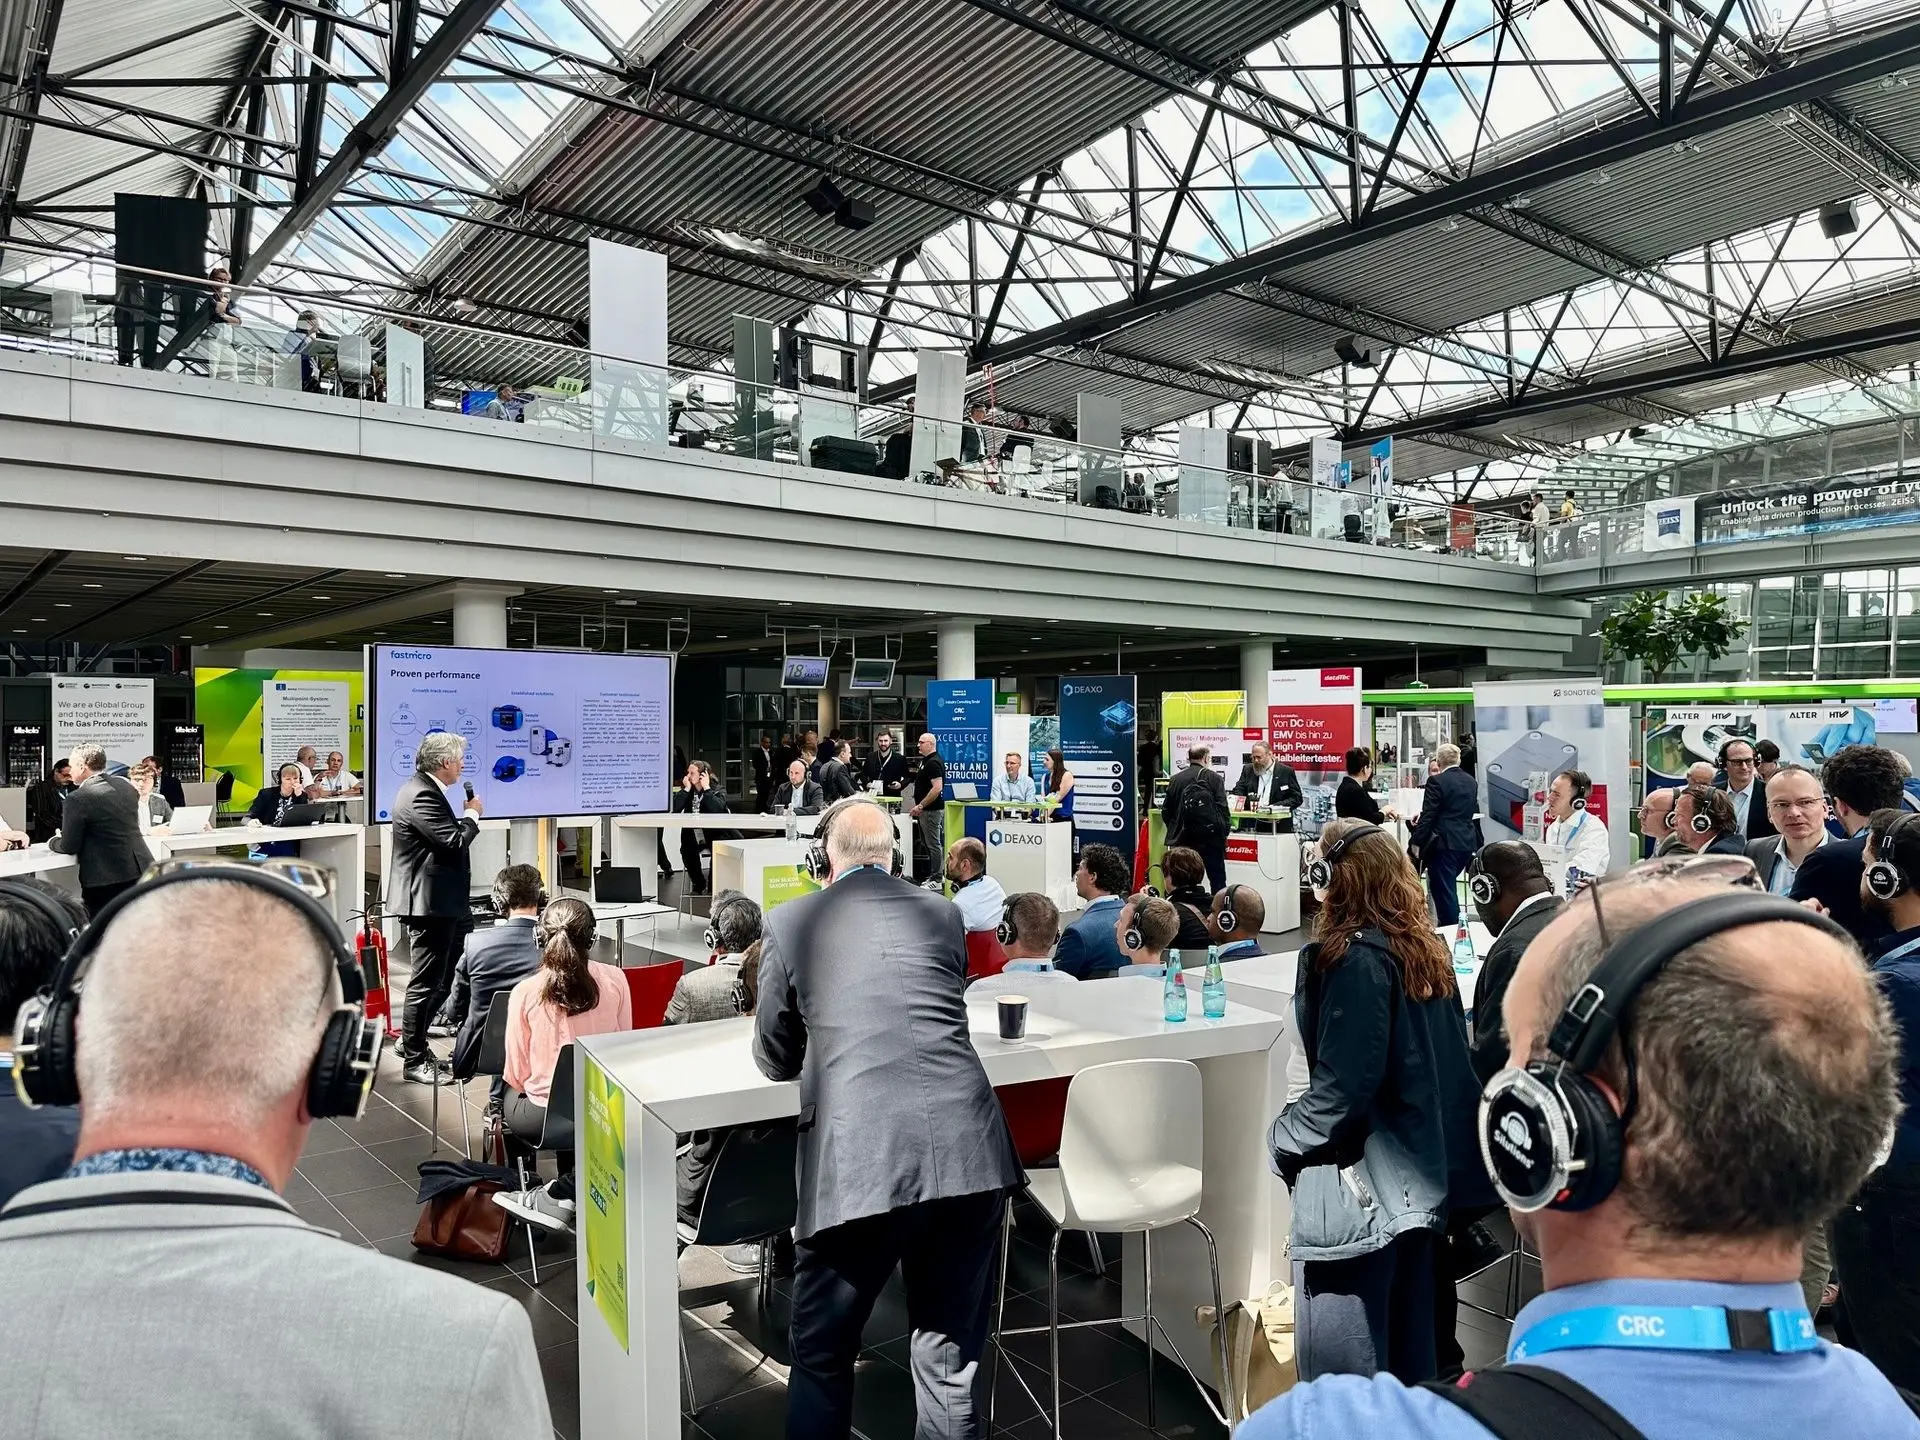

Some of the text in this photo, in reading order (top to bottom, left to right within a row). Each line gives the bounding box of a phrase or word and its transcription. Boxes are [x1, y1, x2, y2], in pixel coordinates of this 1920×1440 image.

[1721, 497, 1775, 514] Unlock
[1781, 494, 1807, 507] the
[1813, 486, 1871, 506] power
[1878, 481, 1898, 495] of
[1720, 496, 1915, 526] Enabling data driven production processes. ZEISS
[1659, 516, 1680, 526] ZEISS
[390, 650, 432, 660] fastmicro
[390, 669, 481, 680] Proven performance
[1074, 686, 1103, 694] DEAXO
[58, 701, 71, 709] We
[95, 701, 120, 709] Global
[121, 701, 145, 710] Group
[75, 711, 110, 719] together
[1671, 712, 1700, 720] ALTER
[1789, 711, 1817, 719] ALTER
[92, 720, 148, 728] Professionals
[1273, 718, 1325, 728] Von DC über
[933, 733, 988, 743] XCELLENCE
[1273, 730, 1294, 739] EMV
[1295, 731, 1307, 739] bis
[1308, 731, 1321, 739] hin
[1273, 742, 1324, 752] High Power
[1273, 753, 1343, 763] Halbleitertester.
[944, 762, 988, 771] SIGN AND
[944, 771, 988, 780] STRUCTION
[1004, 833, 1043, 846] DEAXO
[1617, 1314, 1665, 1337] CRC
